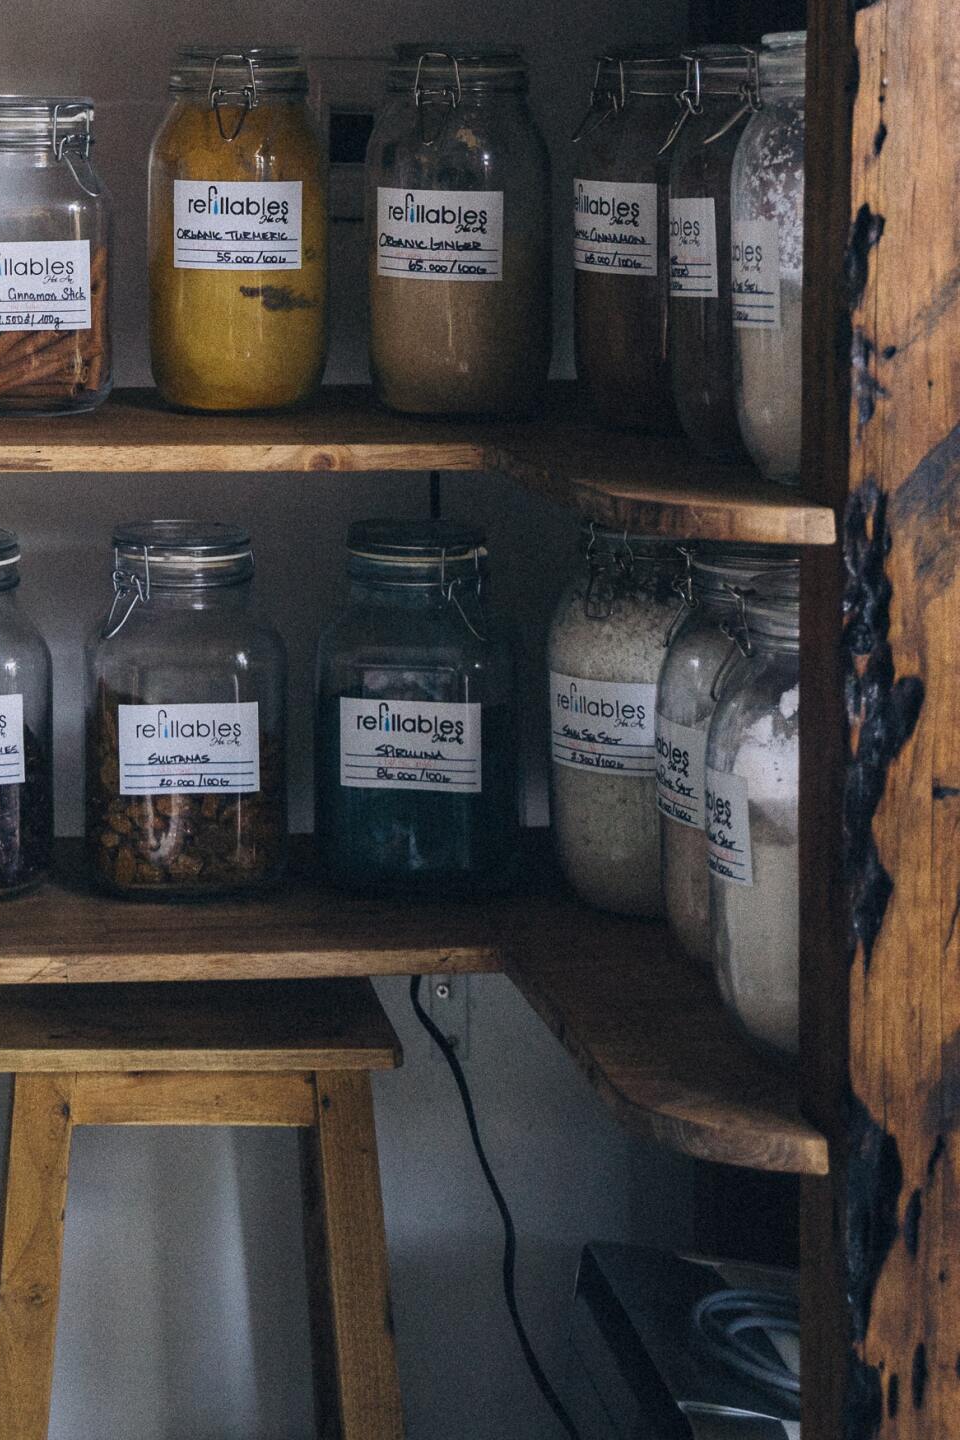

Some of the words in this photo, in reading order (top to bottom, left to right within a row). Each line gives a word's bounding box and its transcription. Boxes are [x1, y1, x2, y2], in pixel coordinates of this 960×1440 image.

[189, 186, 288, 215] refillables
[389, 193, 487, 225] refillables
[177, 228, 222, 240] ORGANIC
[225, 230, 288, 240] TURMERIC
[379, 233, 427, 249] ORGANIC
[8, 288, 57, 301] Cinnamon
[62, 287, 86, 300] Stick
[557, 682, 645, 719] refillables
[136, 710, 241, 738] refillables
[357, 703, 464, 735] refillables
[148, 753, 210, 765] SULTANAS
